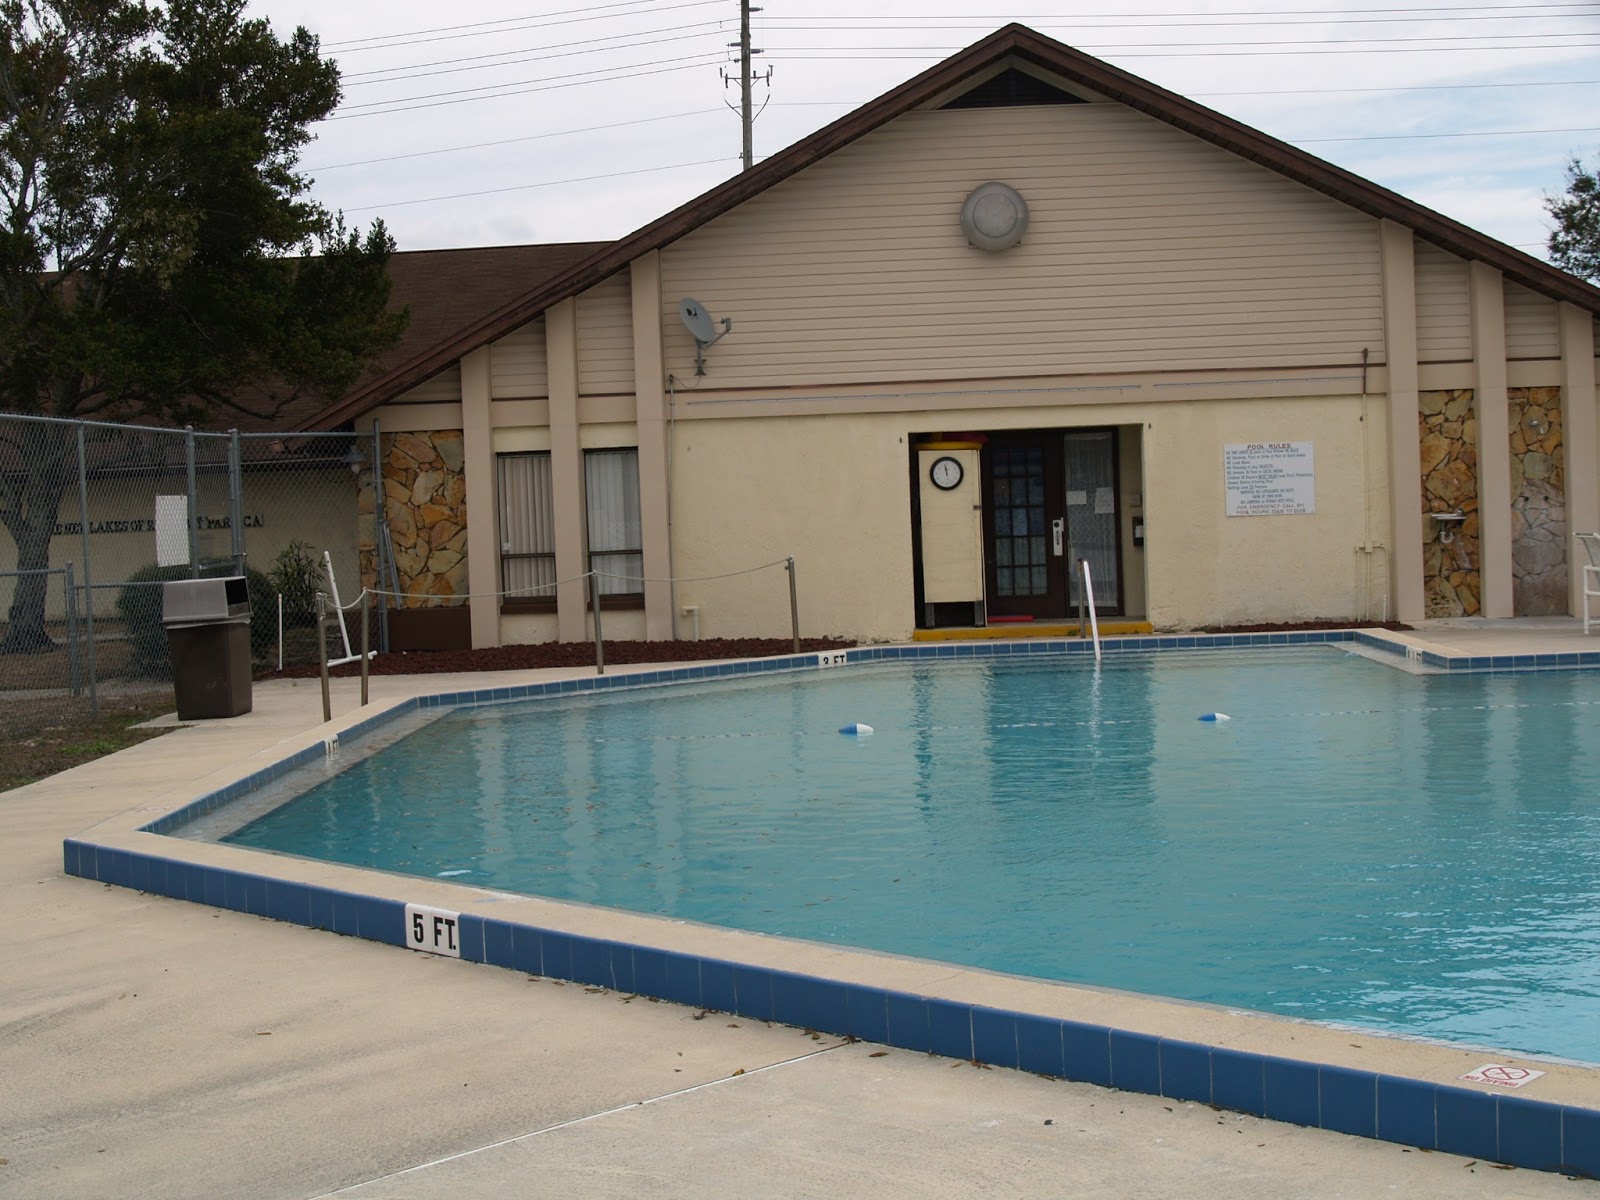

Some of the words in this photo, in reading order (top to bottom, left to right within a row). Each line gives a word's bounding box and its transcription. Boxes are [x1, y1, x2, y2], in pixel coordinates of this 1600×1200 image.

[90, 520, 128, 533] LAKES
[413, 912, 424, 944] 5
[433, 916, 456, 950] FT.
[1480, 1078, 1518, 1087] DIVING
